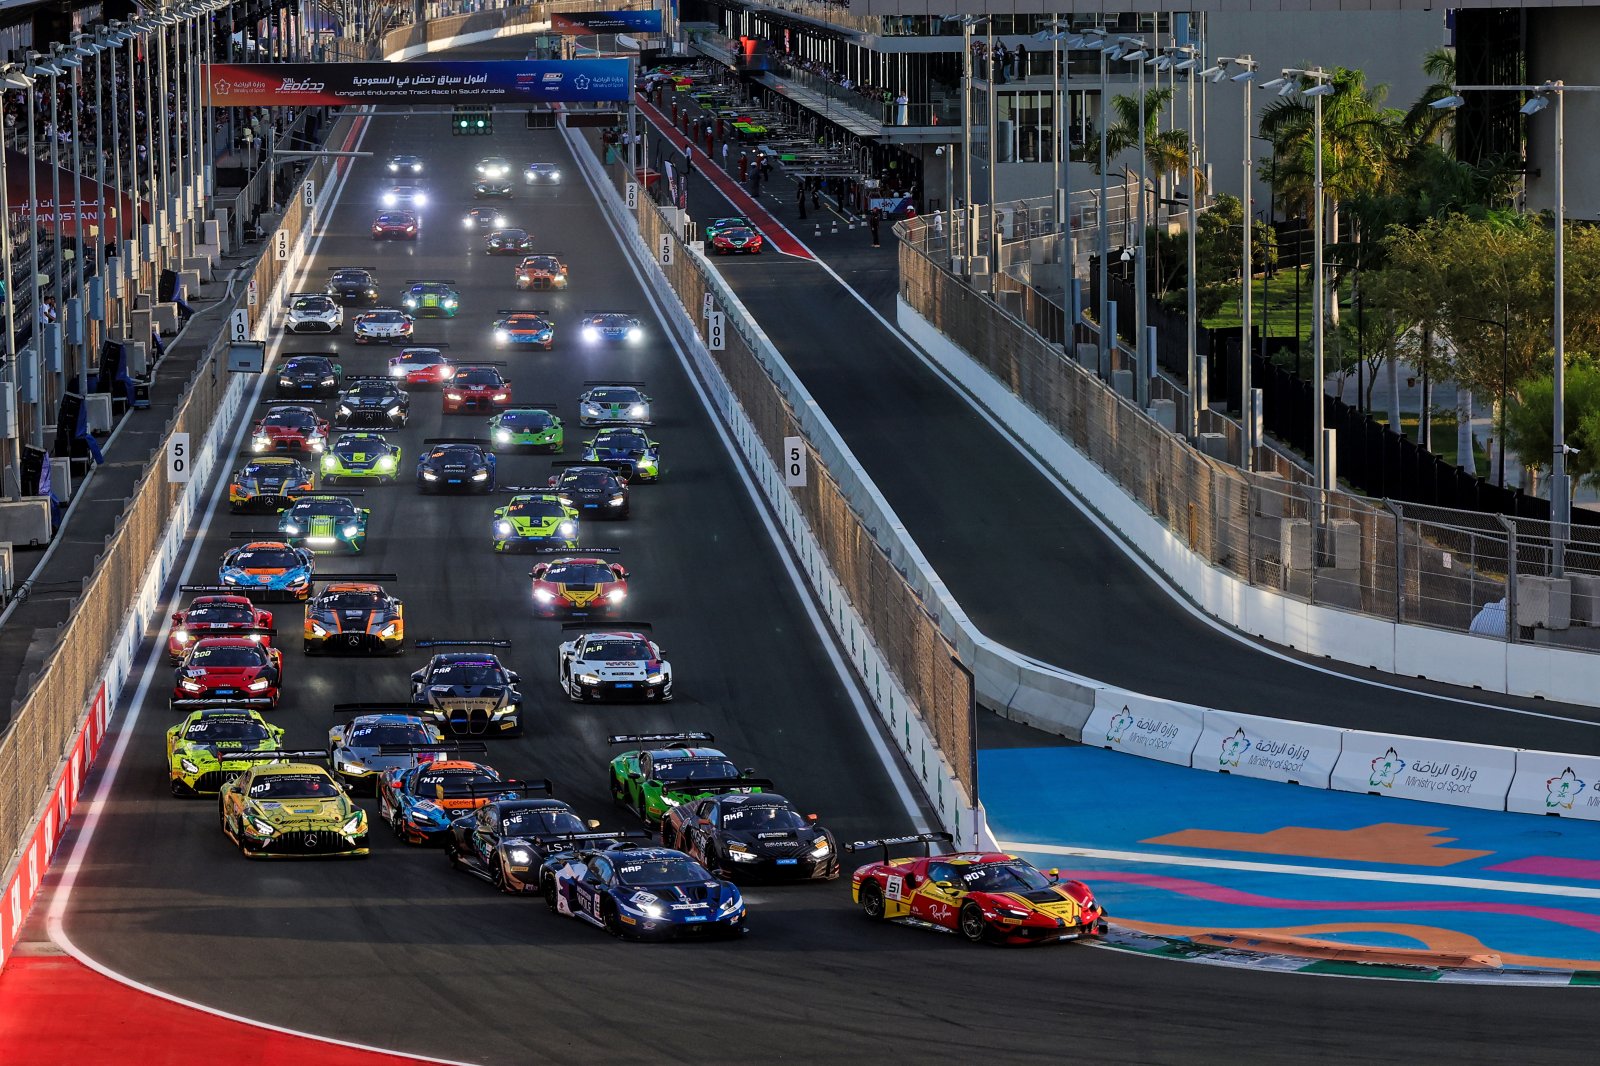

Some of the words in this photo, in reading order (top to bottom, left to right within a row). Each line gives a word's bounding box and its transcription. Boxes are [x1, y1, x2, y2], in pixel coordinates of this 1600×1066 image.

[352, 76, 394, 86] السعودية
[174, 443, 184, 472] 50
[790, 447, 800, 476] 50
[1136, 718, 1161, 734] الرياضة
[1161, 722, 1179, 739] وزارة
[1129, 732, 1148, 746] Ministry
[1155, 738, 1173, 750] Sport
[1255, 740, 1287, 756] الرياضة
[1287, 744, 1310, 761] وزارة
[1248, 754, 1275, 770] Ministry
[1275, 759, 1283, 769] of
[1283, 760, 1303, 772] Sport
[1412, 760, 1450, 778] الرياضة
[1452, 764, 1478, 782] وزارة
[1405, 776, 1436, 791] Ministry
[1436, 781, 1446, 790] of
[1446, 782, 1472, 794] Sport
[888, 882, 900, 893] 51
